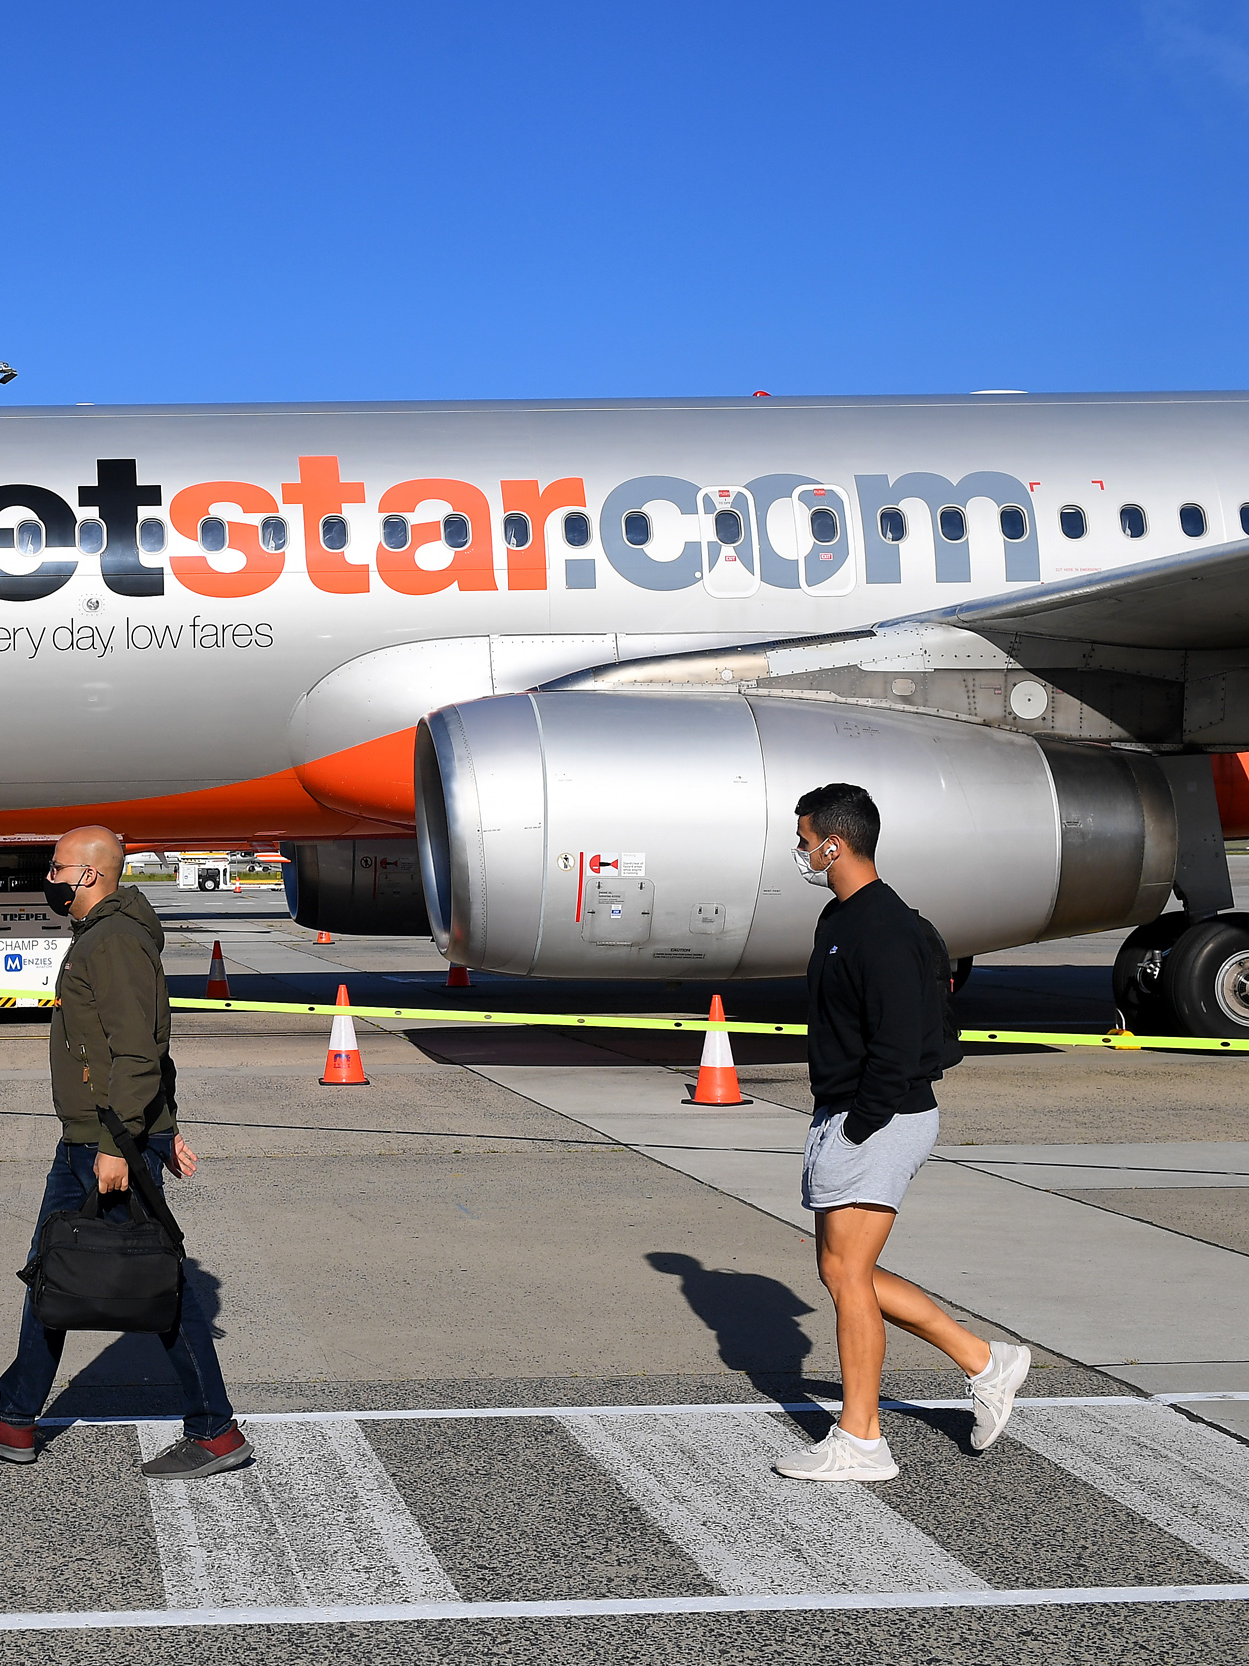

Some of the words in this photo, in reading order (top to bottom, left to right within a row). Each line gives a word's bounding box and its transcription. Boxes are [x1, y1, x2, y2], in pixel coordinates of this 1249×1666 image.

[52, 617, 116, 659] day,
[126, 615, 184, 650] low
[190, 614, 275, 650] fares
[1, 913, 50, 921] TREPEL
[44, 940, 57, 950] 35
